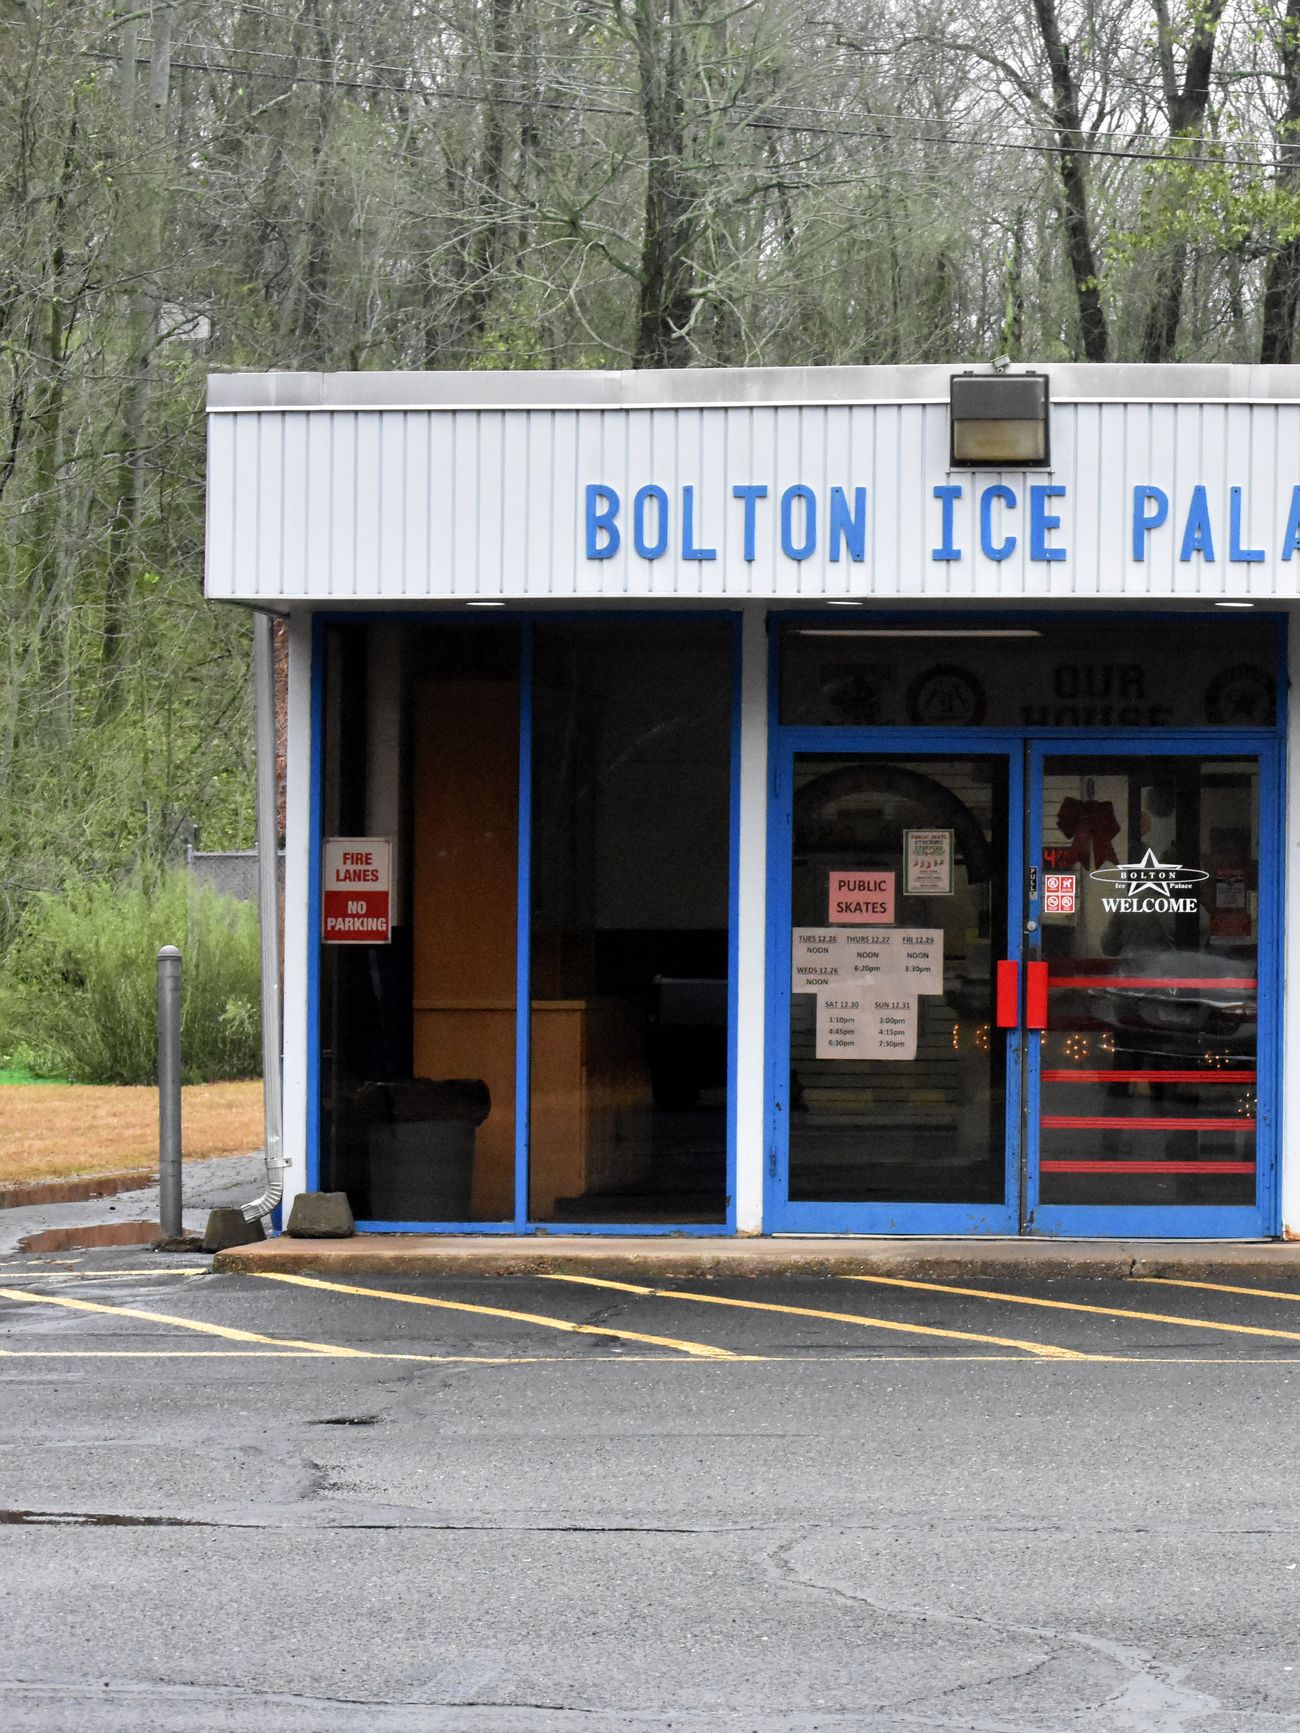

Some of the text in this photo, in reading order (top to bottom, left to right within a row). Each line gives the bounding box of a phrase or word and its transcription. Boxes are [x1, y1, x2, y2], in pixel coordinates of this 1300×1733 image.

[585, 484, 866, 562] BOLTON
[932, 484, 1067, 562] ICE
[1055, 663, 1146, 700] OUR
[342, 853, 372, 865] FIRE
[336, 869, 379, 882] LANES
[838, 880, 887, 892] PUBLIC
[347, 901, 367, 914] NO
[836, 901, 887, 914] SKATES
[1101, 898, 1198, 912] WELCOME
[327, 918, 387, 931] PARKING
[799, 935, 816, 943] TUES
[854, 965, 881, 973] 6:20pm
